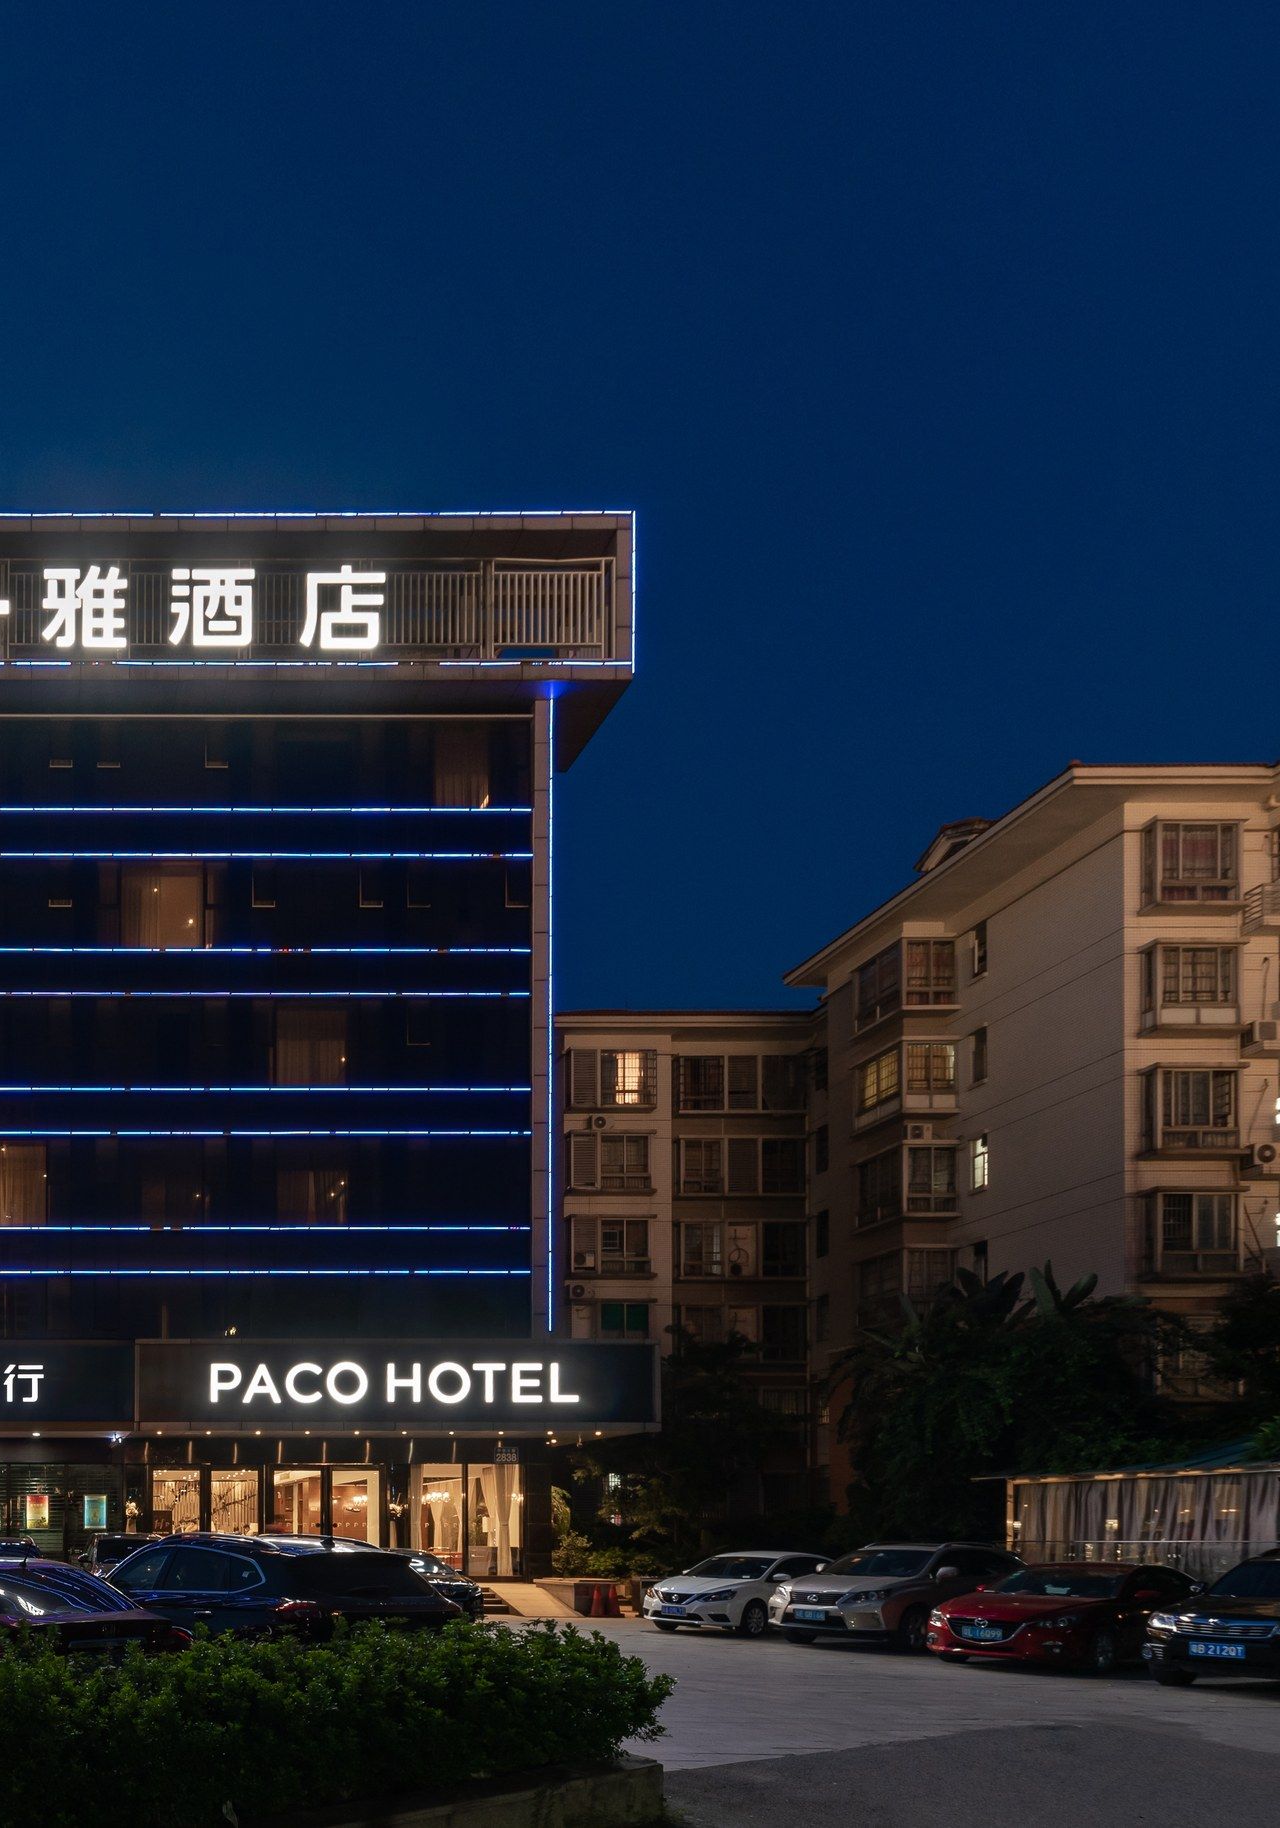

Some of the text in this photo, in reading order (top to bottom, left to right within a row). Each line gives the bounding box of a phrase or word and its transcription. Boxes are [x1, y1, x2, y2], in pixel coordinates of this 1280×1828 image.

[210, 1361, 580, 1404] PACO HOTEL
[496, 1453, 517, 1462] 2838
